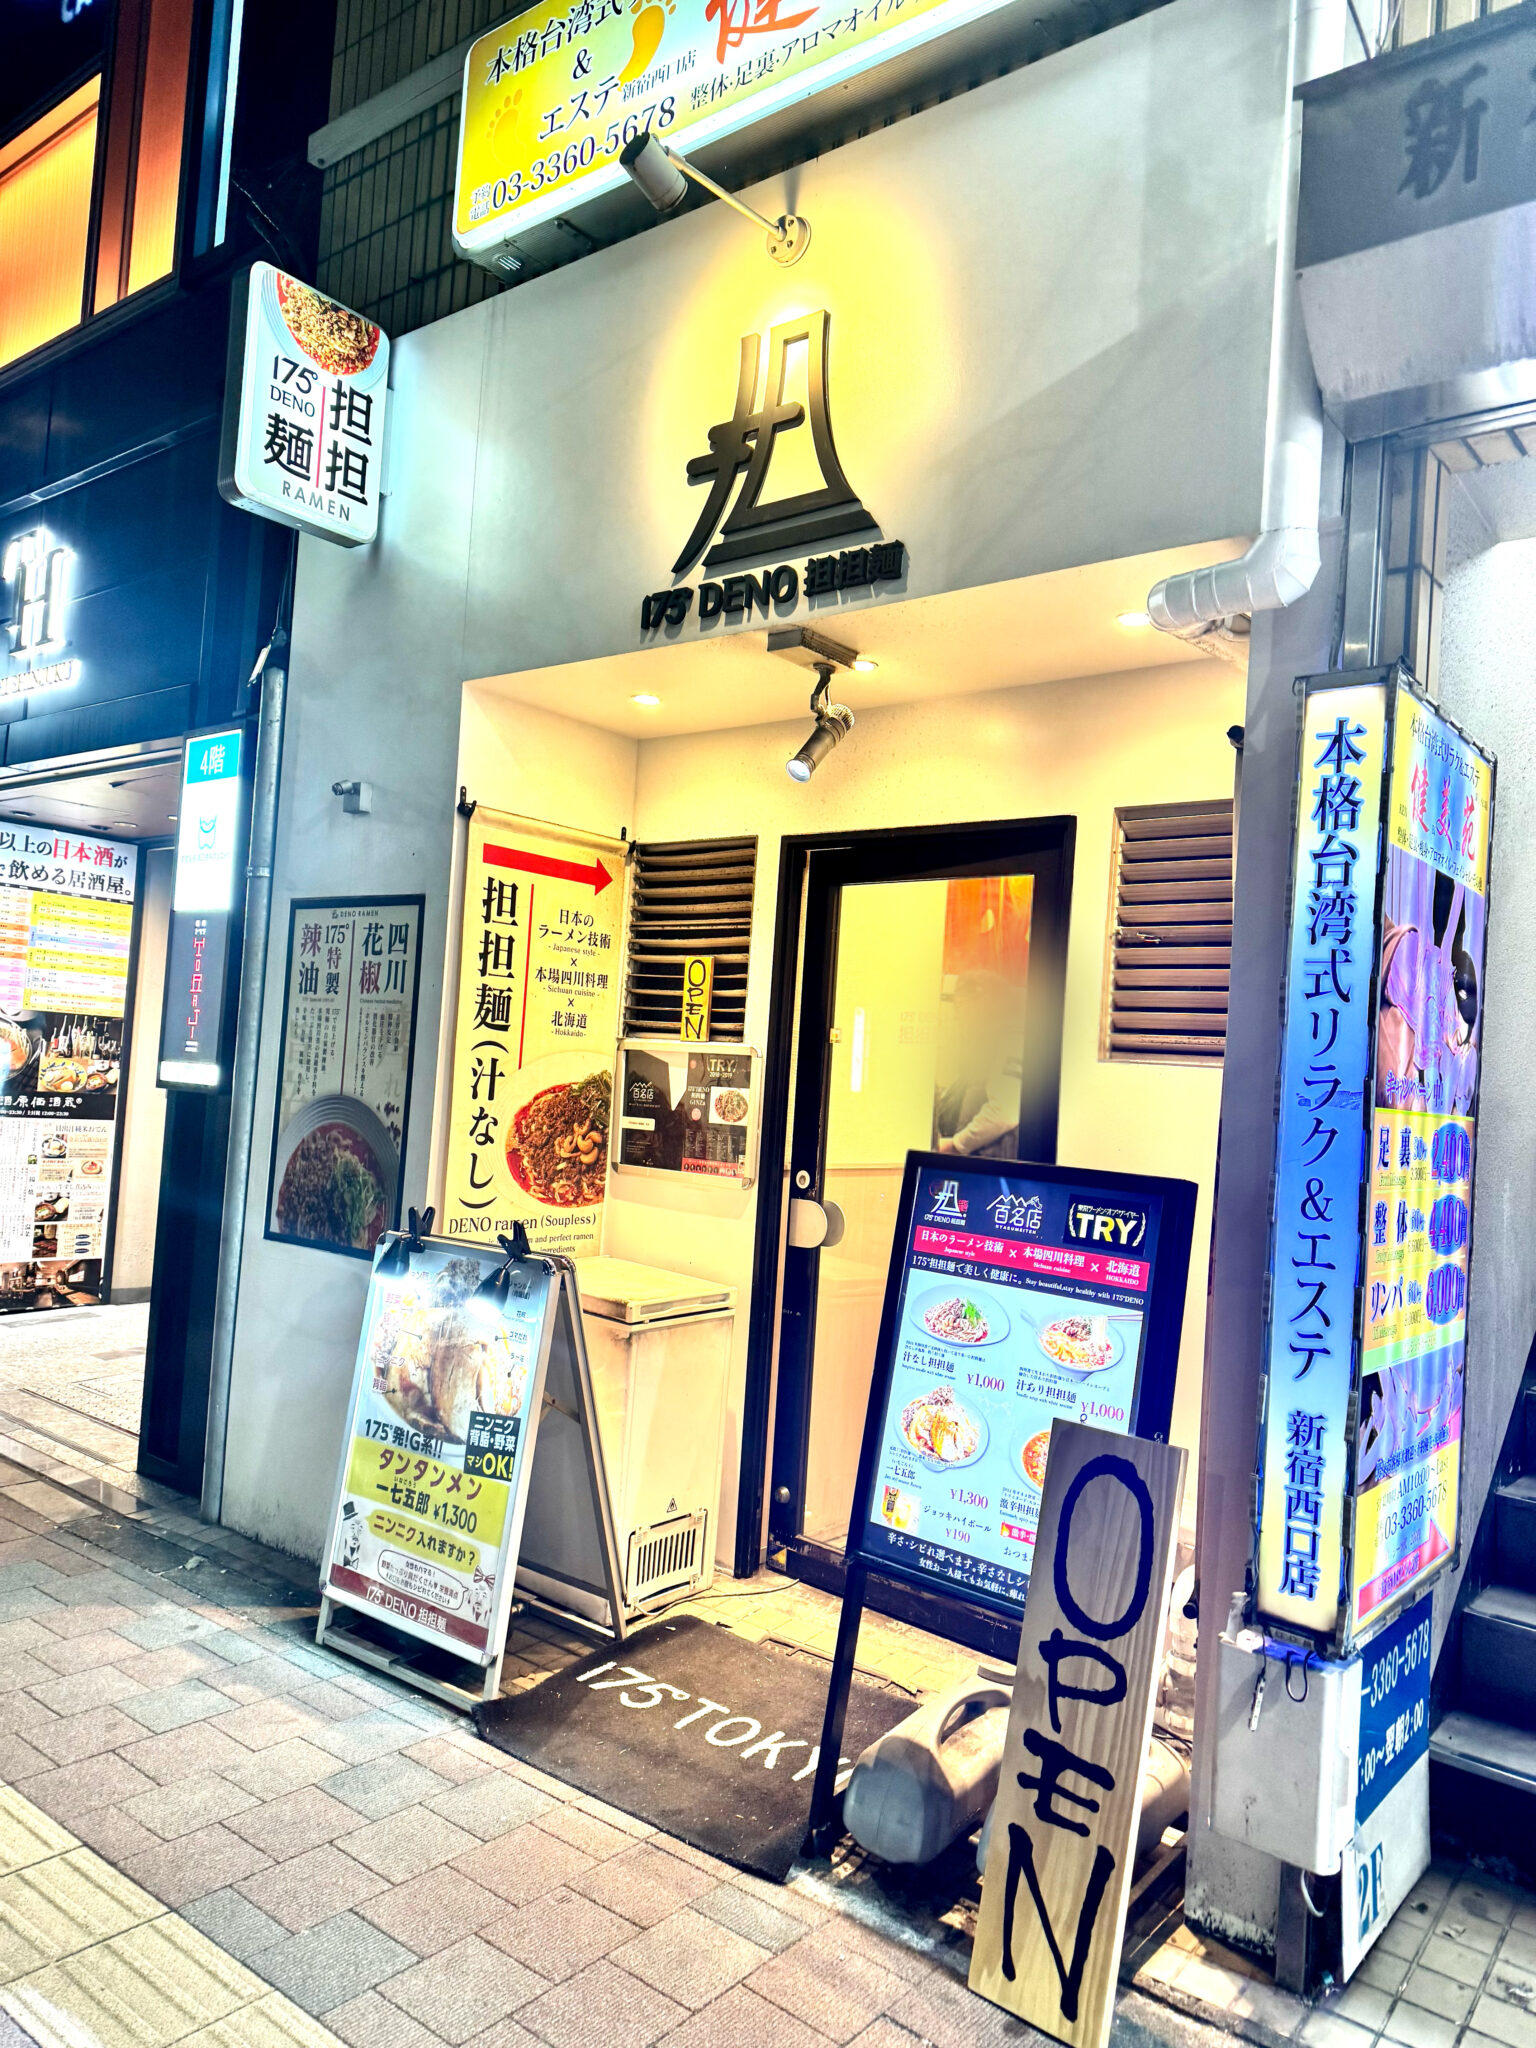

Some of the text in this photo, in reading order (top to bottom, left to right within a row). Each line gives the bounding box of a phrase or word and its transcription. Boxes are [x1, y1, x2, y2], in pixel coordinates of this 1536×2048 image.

[485, 0, 638, 84] 本格台湾式
[572, 48, 593, 80] &
[622, 49, 698, 103] 新宿西口店
[538, 75, 620, 142] エステ
[491, 95, 676, 209] 03-3360-5678
[272, 354, 319, 395] 175°
[270, 384, 315, 418] DENO
[282, 480, 351, 522] RAMEN
[698, 565, 798, 618] DENO
[803, 539, 904, 597] 担担麺
[199, 743, 226, 775] 4階
[1411, 758, 1476, 862] 健美苑
[538, 924, 611, 949] ラーメン技術
[559, 908, 595, 928] 日本の
[298, 923, 322, 996] 辣油
[359, 923, 384, 995] 花椒
[384, 923, 410, 995] 四川
[552, 943, 597, 957] Japanese style
[534, 966, 609, 990] 本場四川料理
[547, 985, 596, 998] Sichuan cuisine
[684, 958, 706, 1040] OPEN
[551, 1010, 588, 1029] 北海道
[709, 1059, 735, 1072] TRY
[633, 1087, 655, 1100] 百名店
[1279, 717, 1367, 1602] 本格台湾式リラク&エステ 新宿西口店
[448, 1216, 492, 1235] DENO
[540, 1212, 597, 1230] (Soupless)
[994, 1204, 1043, 1230] 百名店
[1076, 1213, 1138, 1245] TRY
[549, 1234, 572, 1245] perfect
[573, 1233, 595, 1241] ramen
[921, 1229, 1004, 1254] 日本のラーメン技術
[1023, 1246, 1086, 1268] 本場四川料理
[1105, 1259, 1141, 1278] 北海道
[1370, 1275, 1404, 1323] リンパ
[509, 1331, 527, 1340] ゴマだれ
[903, 1350, 955, 1373] 汁なし担担麺
[967, 1373, 1005, 1392] ¥1,000
[1016, 1379, 1125, 1422] 汁あり担担麺 ¥1,000
[469, 1429, 517, 1453] 背脂・野菜
[474, 1416, 514, 1434] ニンニク
[379, 1448, 483, 1501] タンタンメン
[466, 1452, 515, 1479] マシOK!
[376, 1483, 478, 1534] 一七五郎 ¥1,300
[923, 1505, 992, 1532] ジョッキハイボール
[950, 1488, 989, 1510] ¥1,300
[1384, 1479, 1448, 1541] 03-3360-5678
[373, 1514, 475, 1566] ニンニク入れますか?
[945, 1528, 971, 1544] ¥190
[1003, 1546, 1034, 1562] おつま
[384, 1593, 417, 1620] DENO
[417, 1607, 448, 1633] 担担麺
[1002, 1454, 1154, 2024] OPEN
[1358, 1697, 1424, 1792] :00~翌朝2:00
[1359, 1841, 1384, 1944] 2F
